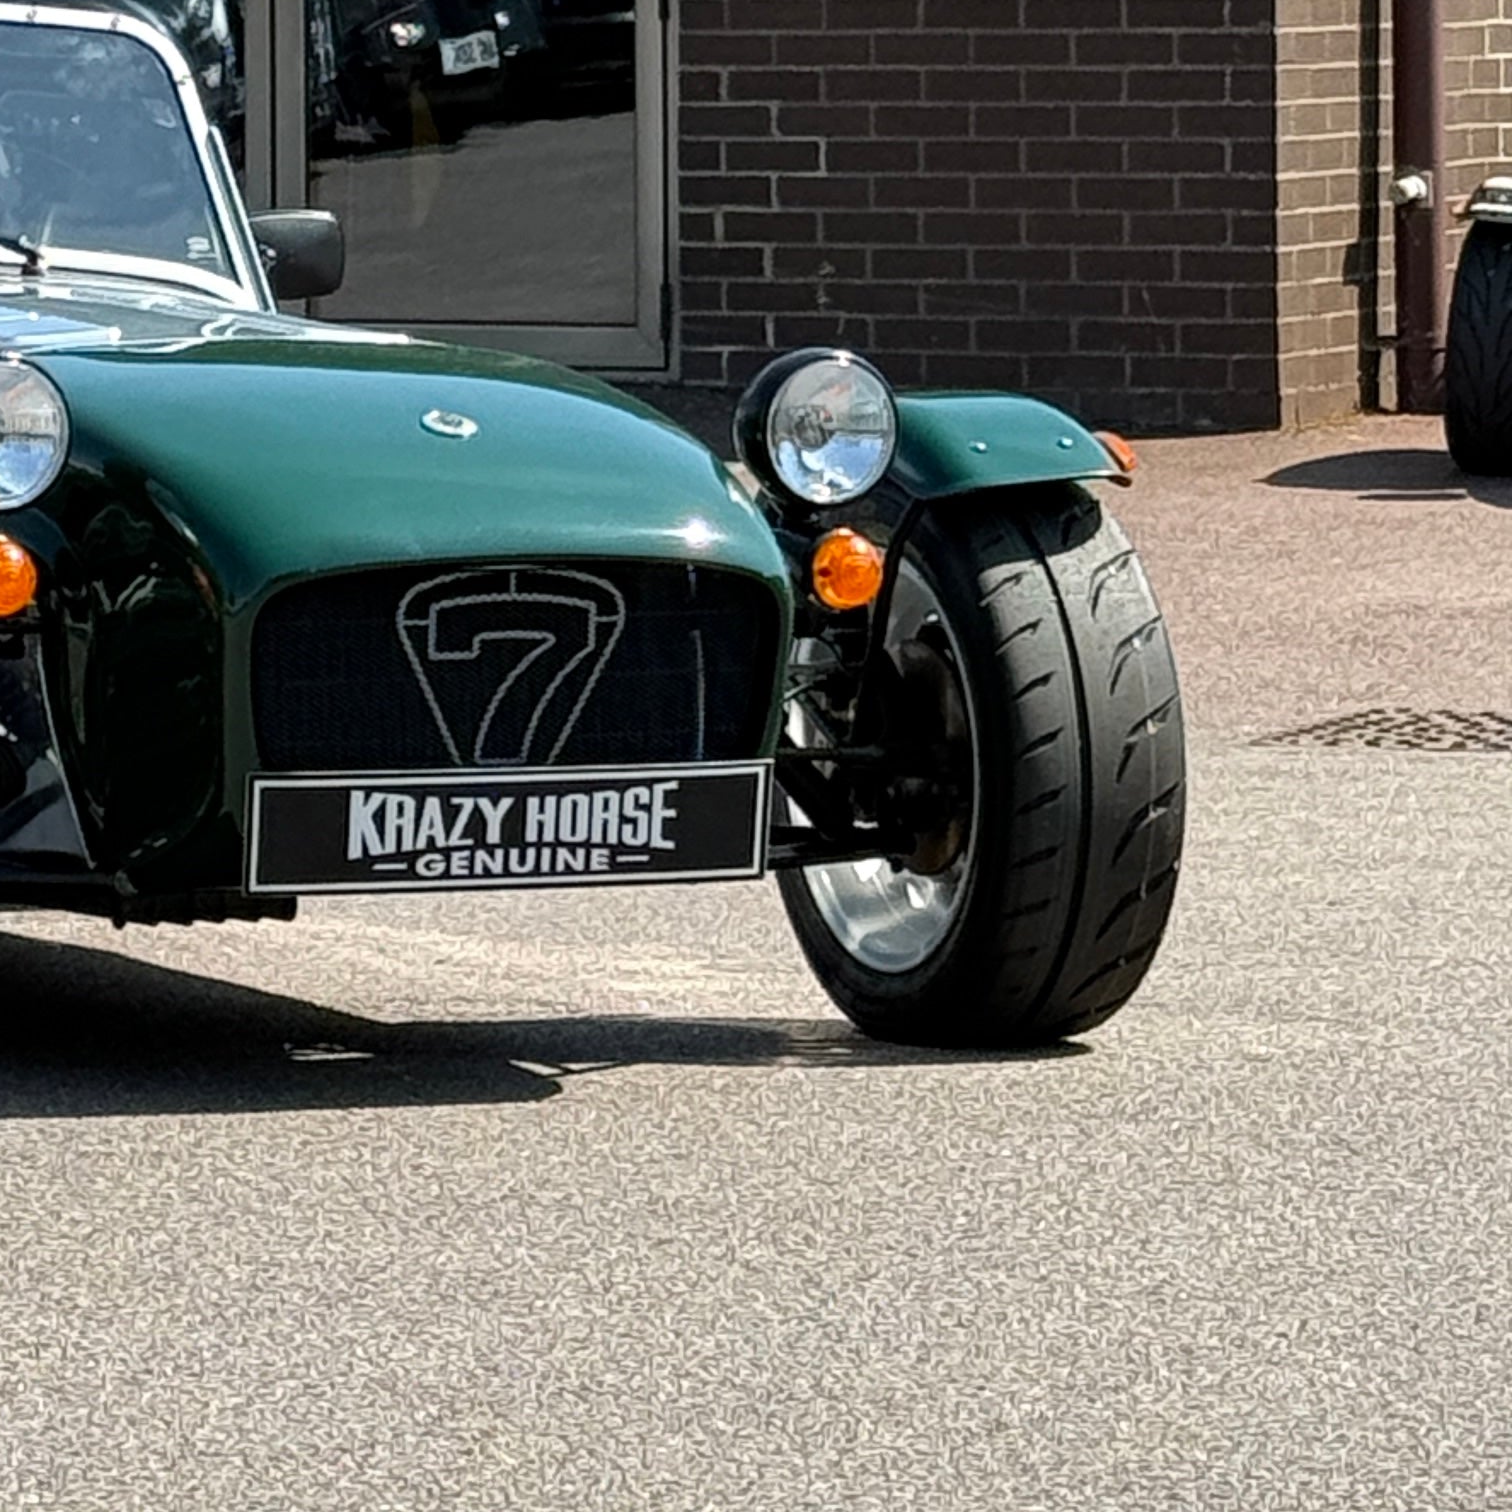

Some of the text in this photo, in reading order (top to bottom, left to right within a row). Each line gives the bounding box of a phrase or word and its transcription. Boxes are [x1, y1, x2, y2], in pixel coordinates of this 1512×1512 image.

[428, 592, 597, 765] 7
[347, 780, 680, 862] KRAZY HORSE
[414, 847, 611, 878] GENUINE
